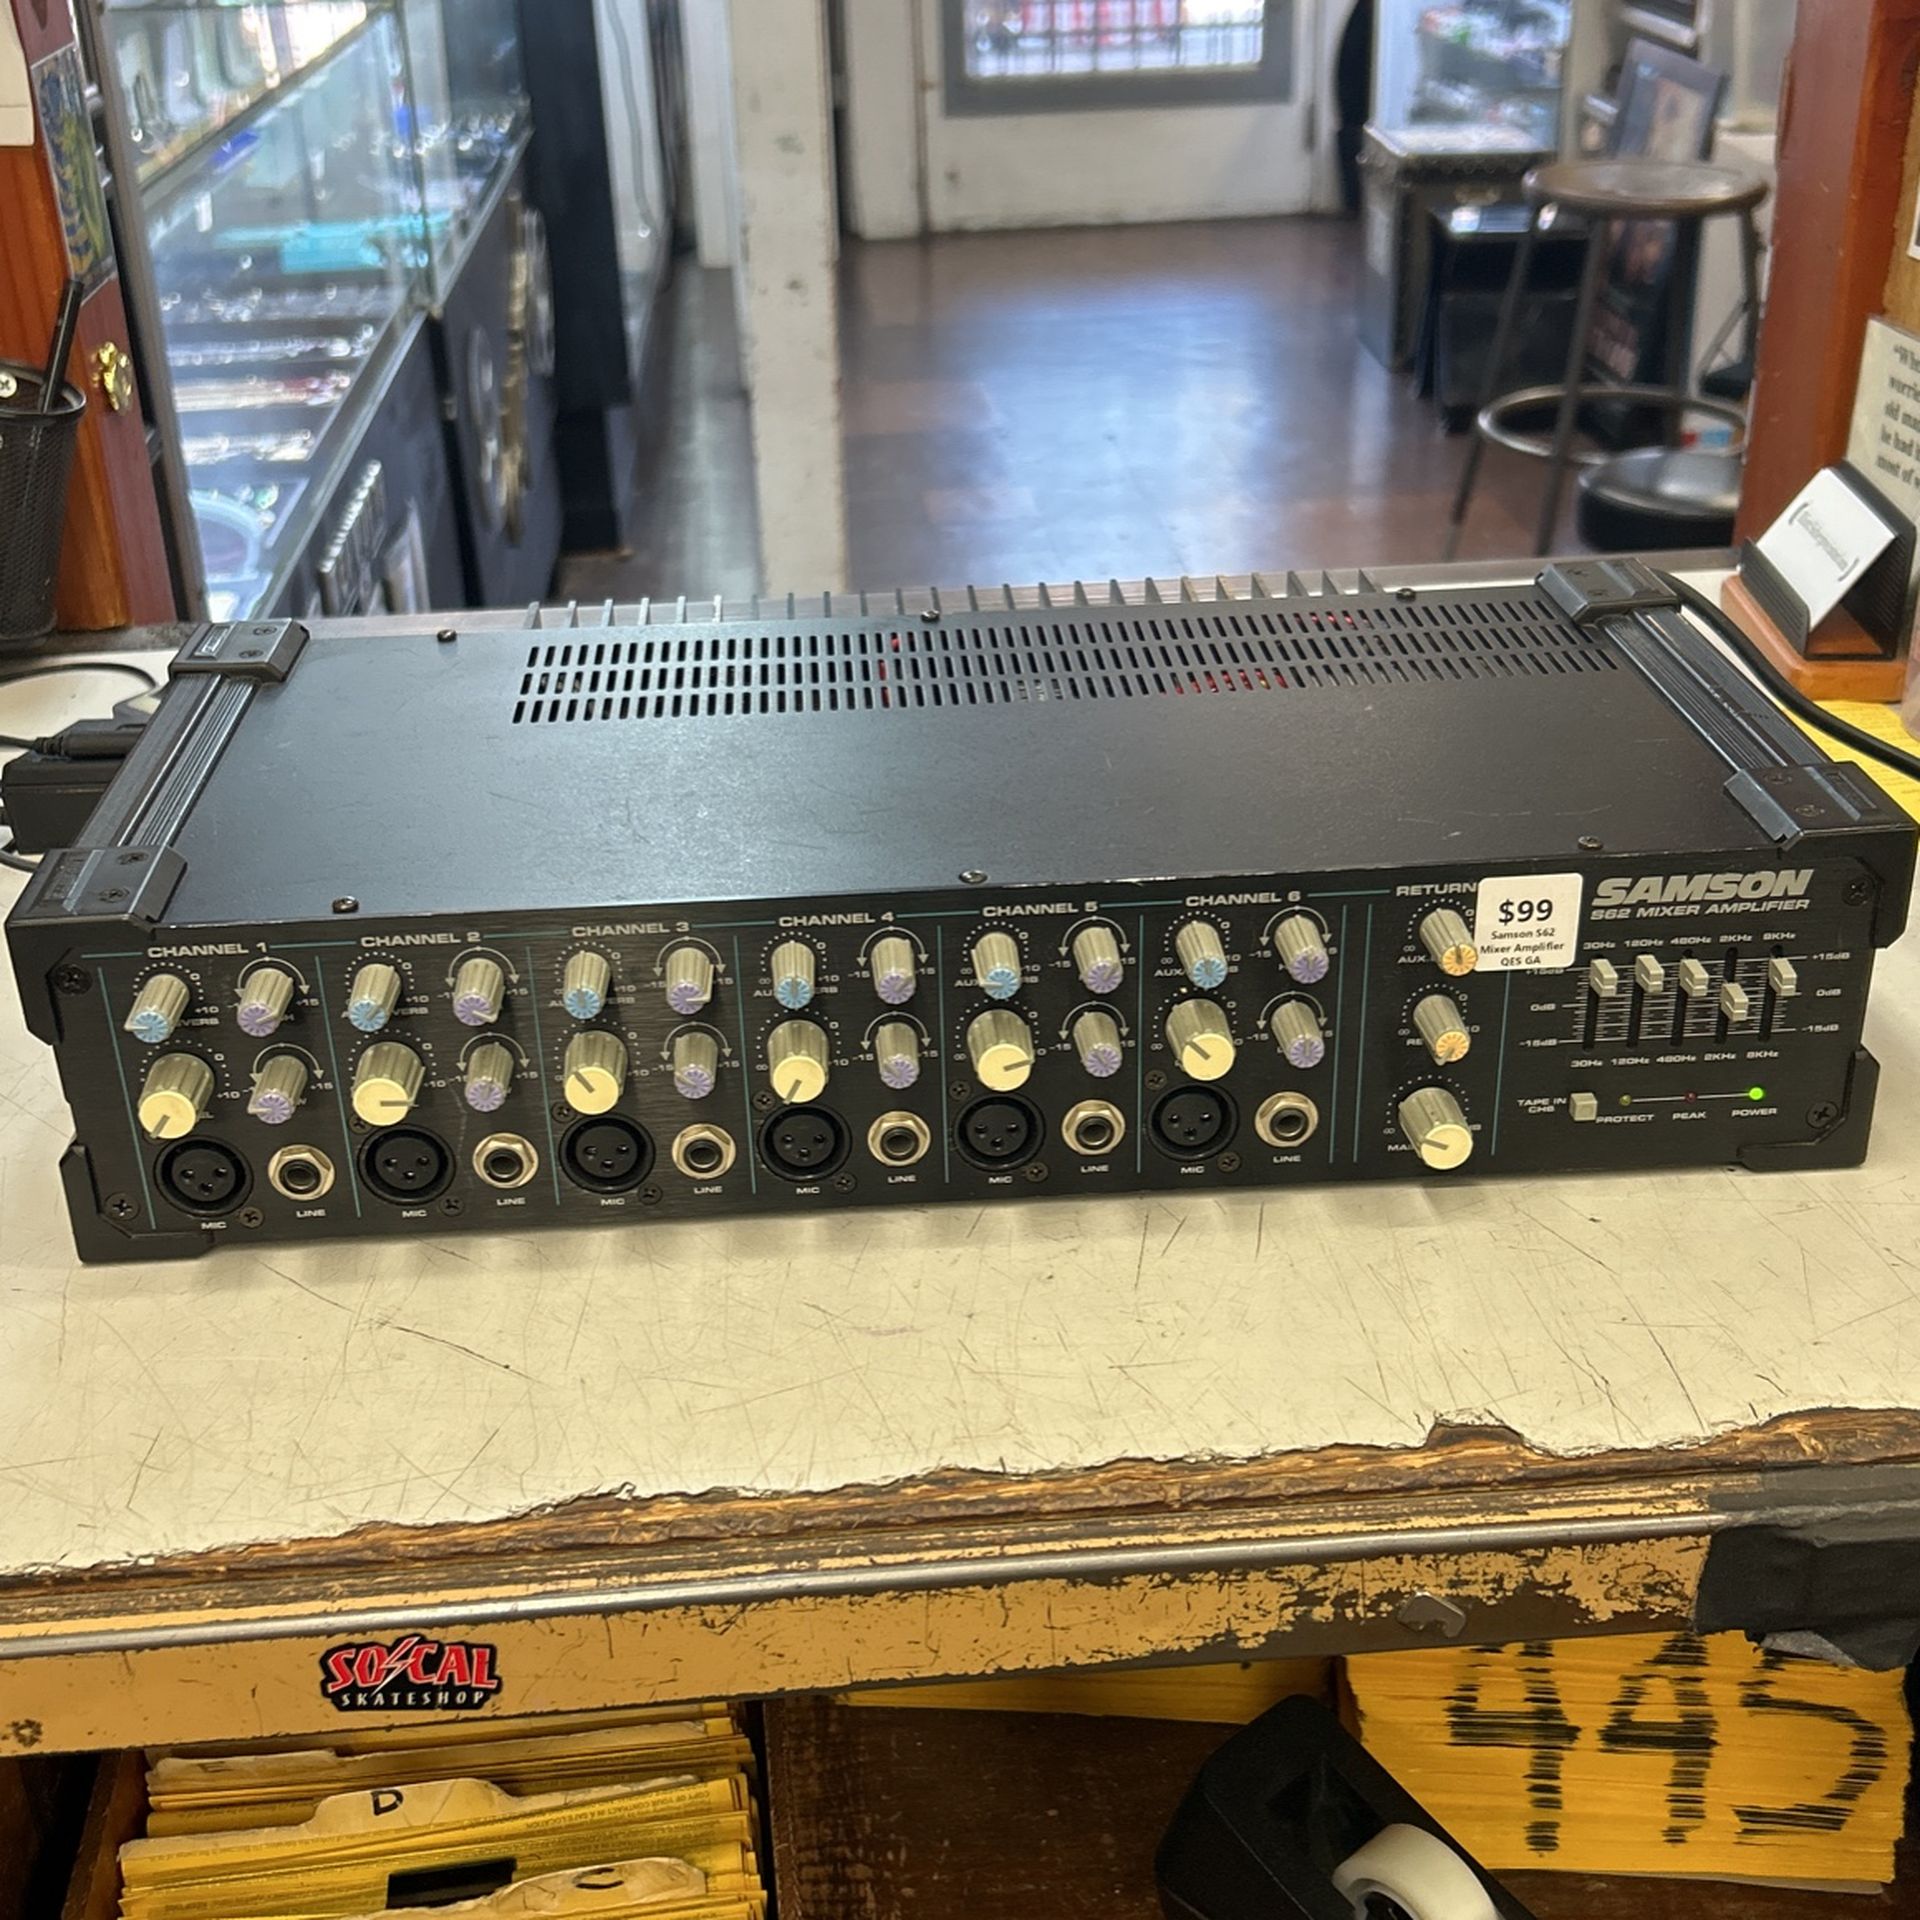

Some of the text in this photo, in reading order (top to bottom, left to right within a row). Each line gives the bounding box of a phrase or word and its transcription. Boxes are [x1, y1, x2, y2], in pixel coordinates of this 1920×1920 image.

[1591, 868, 1814, 907] SAMSON
[1185, 890, 1301, 907] CHANNEL 6
[982, 901, 1098, 917] CHANNEL 5
[1499, 898, 1553, 927] $99
[1589, 899, 1810, 921] S62 MIXER AMPLIFIER
[778, 911, 895, 927] CHANNEL 4
[571, 921, 690, 938] CHANNEL 3
[1491, 927, 1556, 940] Samson S62
[360, 931, 481, 948] CHANNEL 2
[147, 942, 268, 958] CHANNEL 1
[1480, 941, 1564, 954] Mixer Amplifier
[1517, 1097, 1567, 1107] TAPE IN
[1595, 1107, 1778, 1124] PROTECT PEAK POWER
[1273, 1154, 1302, 1164] LINE
[1081, 1164, 1110, 1174] LINE
[1180, 1165, 1204, 1174] MIC
[888, 1174, 917, 1184] LINE
[989, 1175, 1013, 1184] MIC
[693, 1185, 723, 1195] LINE
[796, 1186, 820, 1195] MIC
[496, 1197, 526, 1207] LINE
[601, 1198, 626, 1206] MIC
[296, 1208, 326, 1218] LINE
[402, 1209, 427, 1219] MIC
[201, 1220, 227, 1230] MIC
[341, 1690, 485, 1706] SKATESHOP
[371, 1788, 403, 1816] D
[573, 1867, 625, 1890] C
